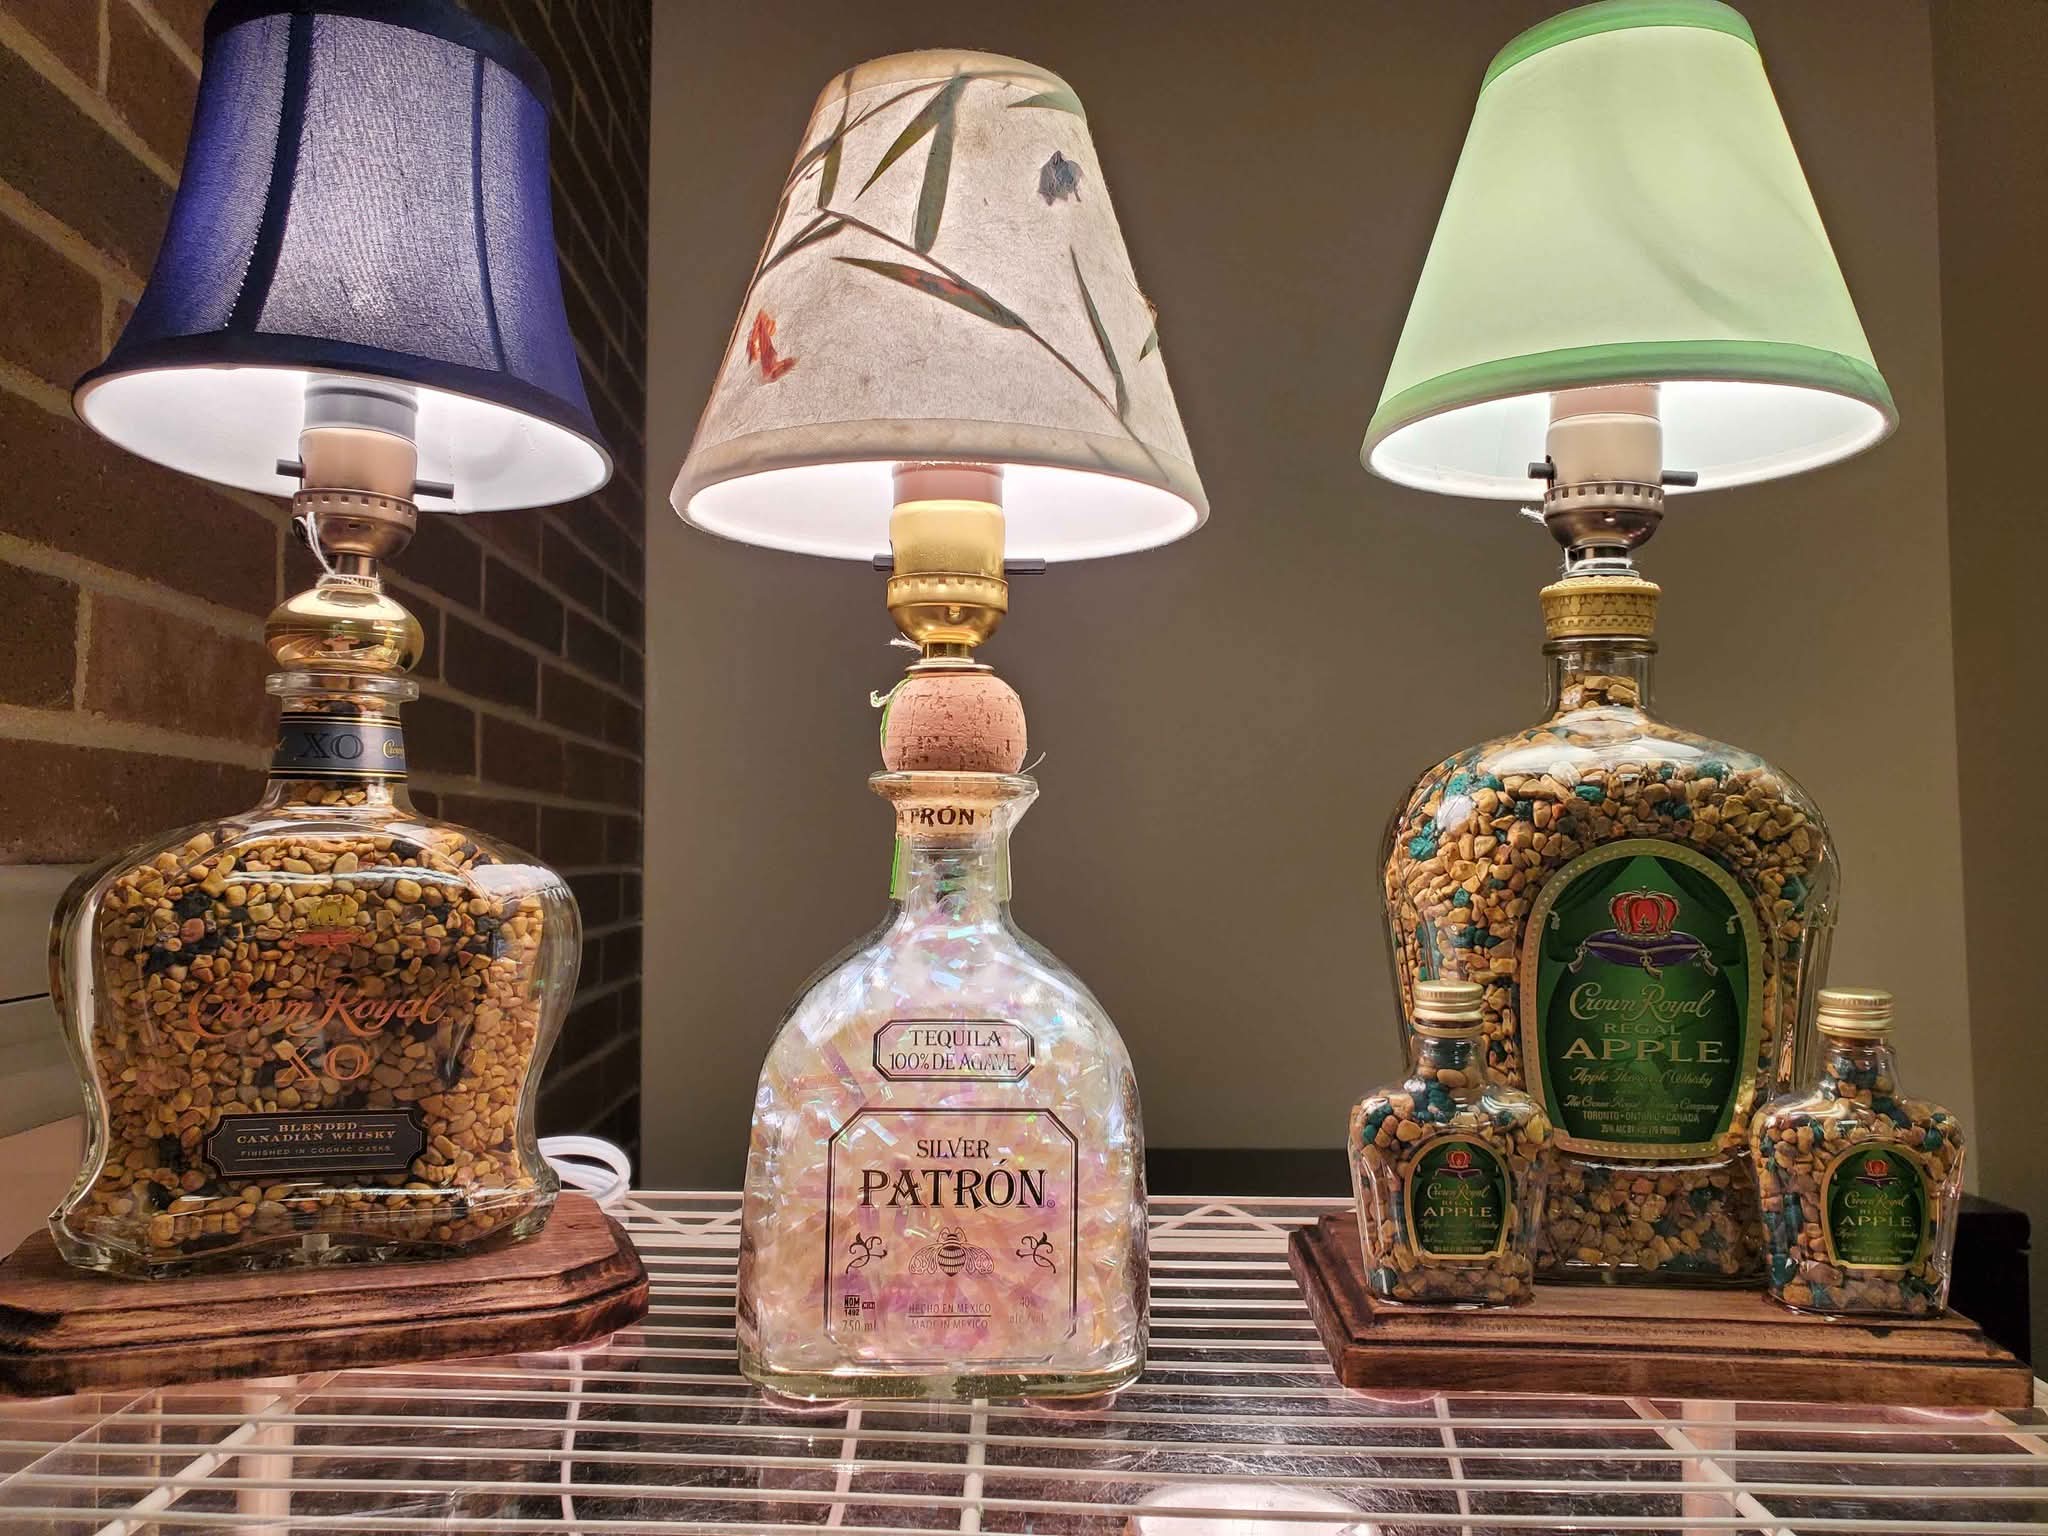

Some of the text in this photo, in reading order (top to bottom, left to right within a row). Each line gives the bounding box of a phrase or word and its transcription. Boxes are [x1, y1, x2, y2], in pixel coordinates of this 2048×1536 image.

[297, 732, 364, 760] XO
[188, 973, 451, 1039] Crown Royal
[1569, 982, 1716, 1023] Crown Royal
[1603, 1023, 1681, 1035] REGAL
[908, 1029, 1002, 1049] TEQUILA
[1560, 1037, 1724, 1063] APPLE
[274, 1043, 370, 1081] XO
[888, 1052, 1017, 1071] 100% DE AGAVE
[1583, 1111, 1620, 1121] TORONTO
[279, 1122, 358, 1133] BLENDED
[236, 1130, 396, 1145] CANADIAN WHISKY
[240, 1148, 291, 1158] FINISHED
[310, 1146, 352, 1155] COGNAC
[916, 1136, 992, 1160] SILVER
[858, 1159, 1048, 1211] PATRÓN
[1423, 1206, 1493, 1217] APPLE
[1840, 1215, 1913, 1227] APPLE
